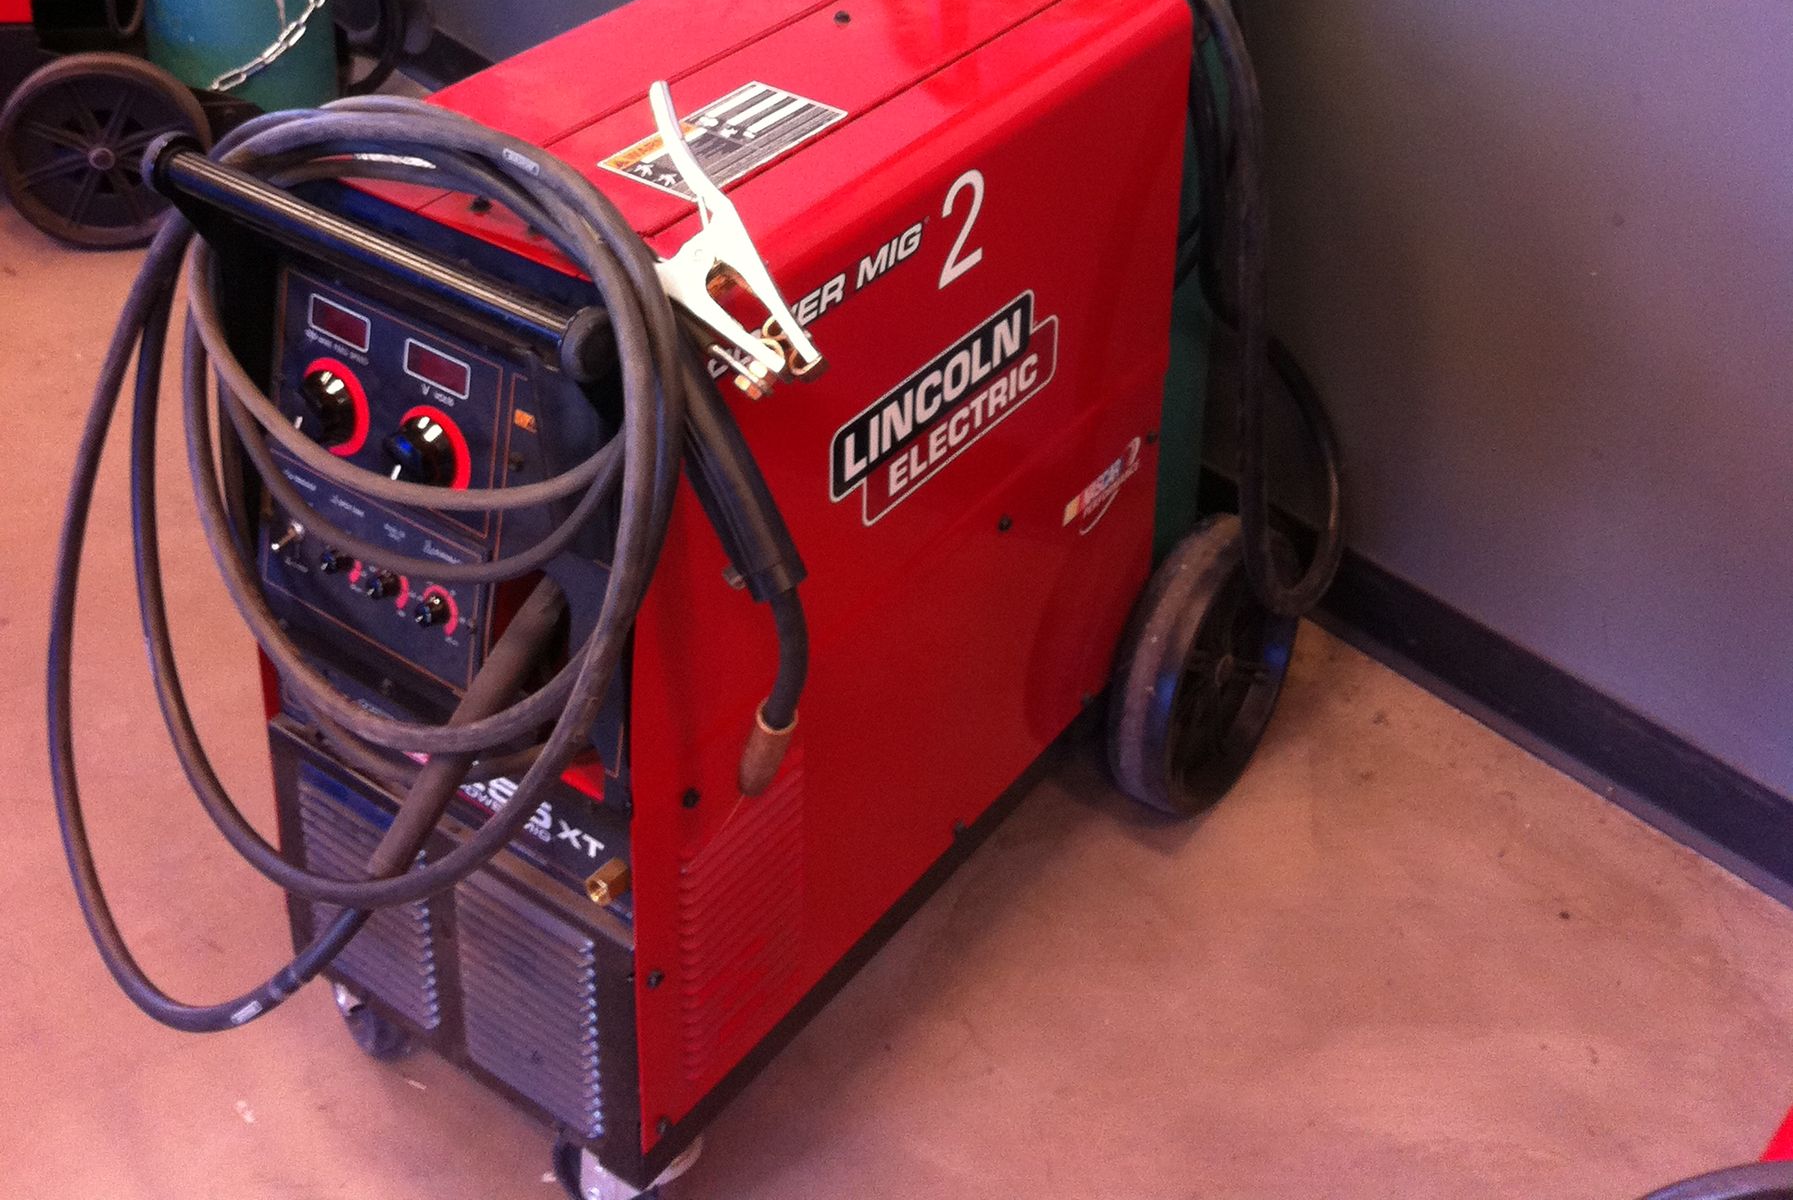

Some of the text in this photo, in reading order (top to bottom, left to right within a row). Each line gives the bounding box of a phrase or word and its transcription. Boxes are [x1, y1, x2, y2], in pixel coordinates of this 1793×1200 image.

[855, 221, 923, 290] MIG
[938, 168, 985, 290] 2
[843, 308, 1022, 483] LINCOLN
[887, 353, 1039, 498] ELECTRIC
[556, 818, 606, 859] XT
